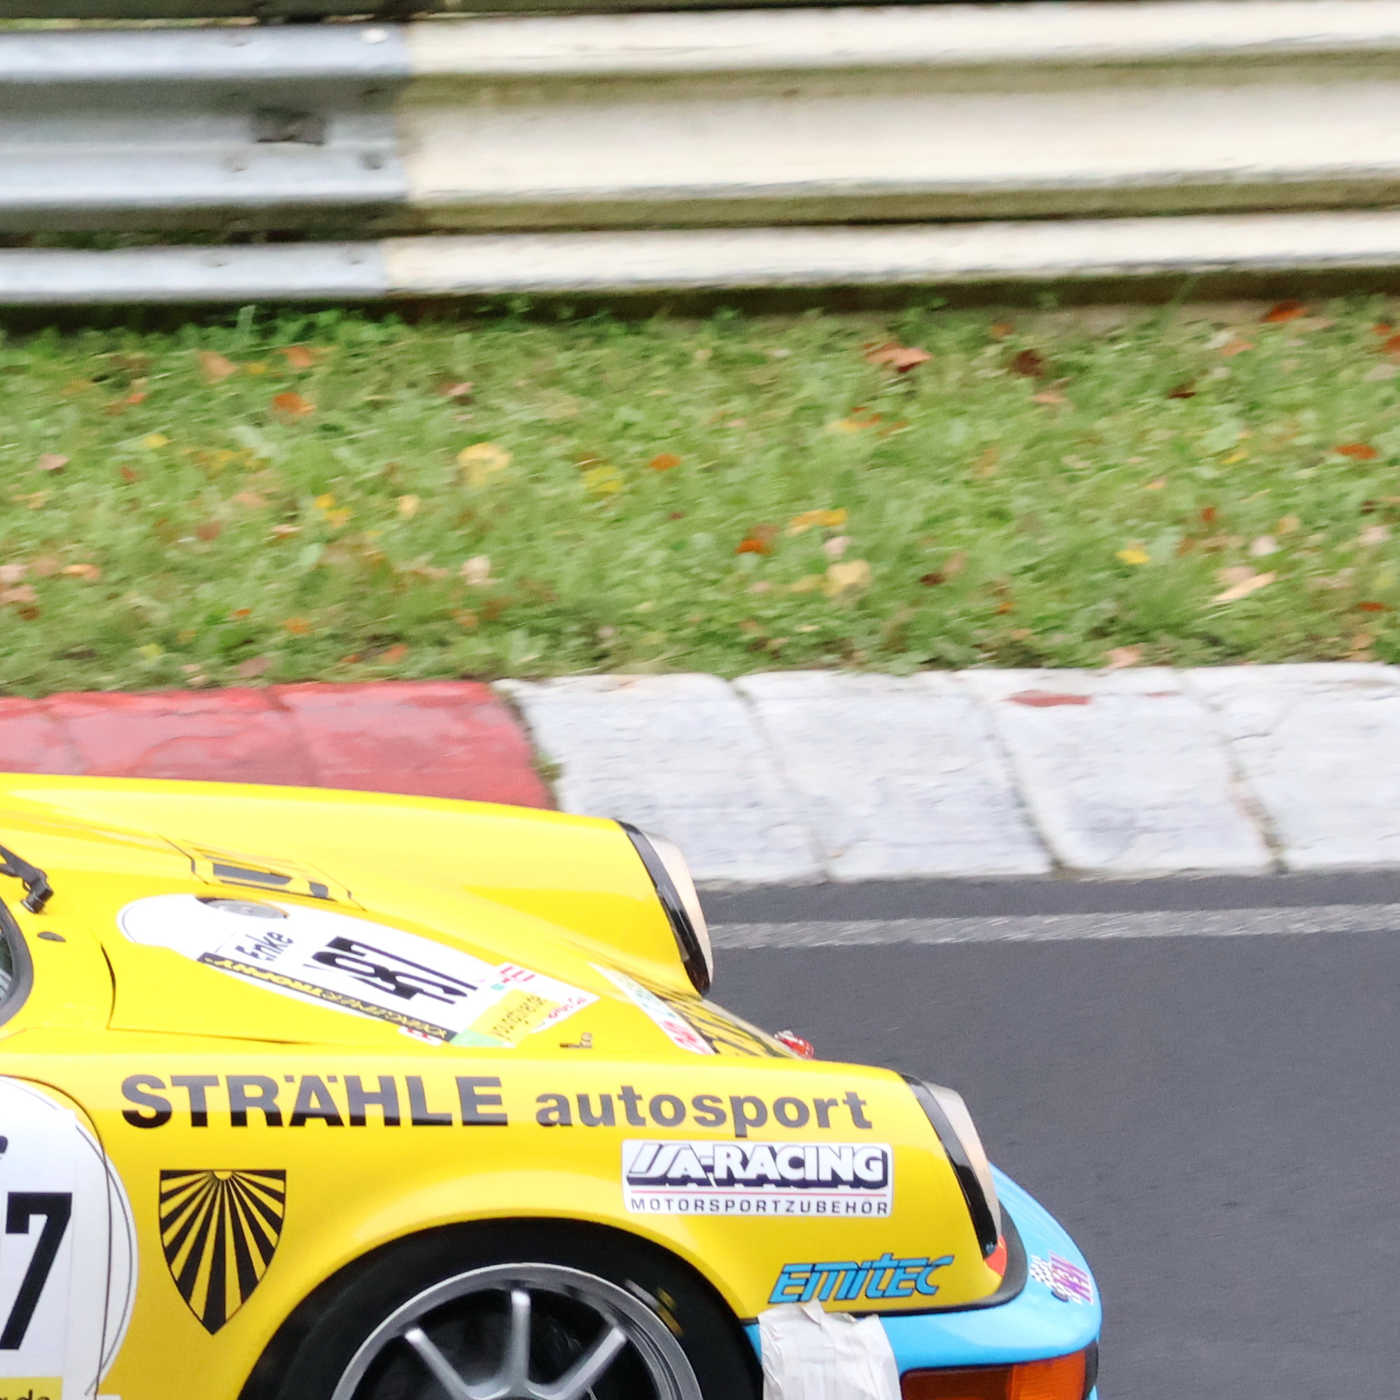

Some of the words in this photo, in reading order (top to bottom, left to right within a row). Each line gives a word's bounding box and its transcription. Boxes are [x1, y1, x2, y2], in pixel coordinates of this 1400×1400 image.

[120, 1074, 509, 1130] STRÄHLE
[535, 1085, 874, 1137] autosport
[630, 1197, 889, 1215] MOTORSPORTZUBEHÖR
